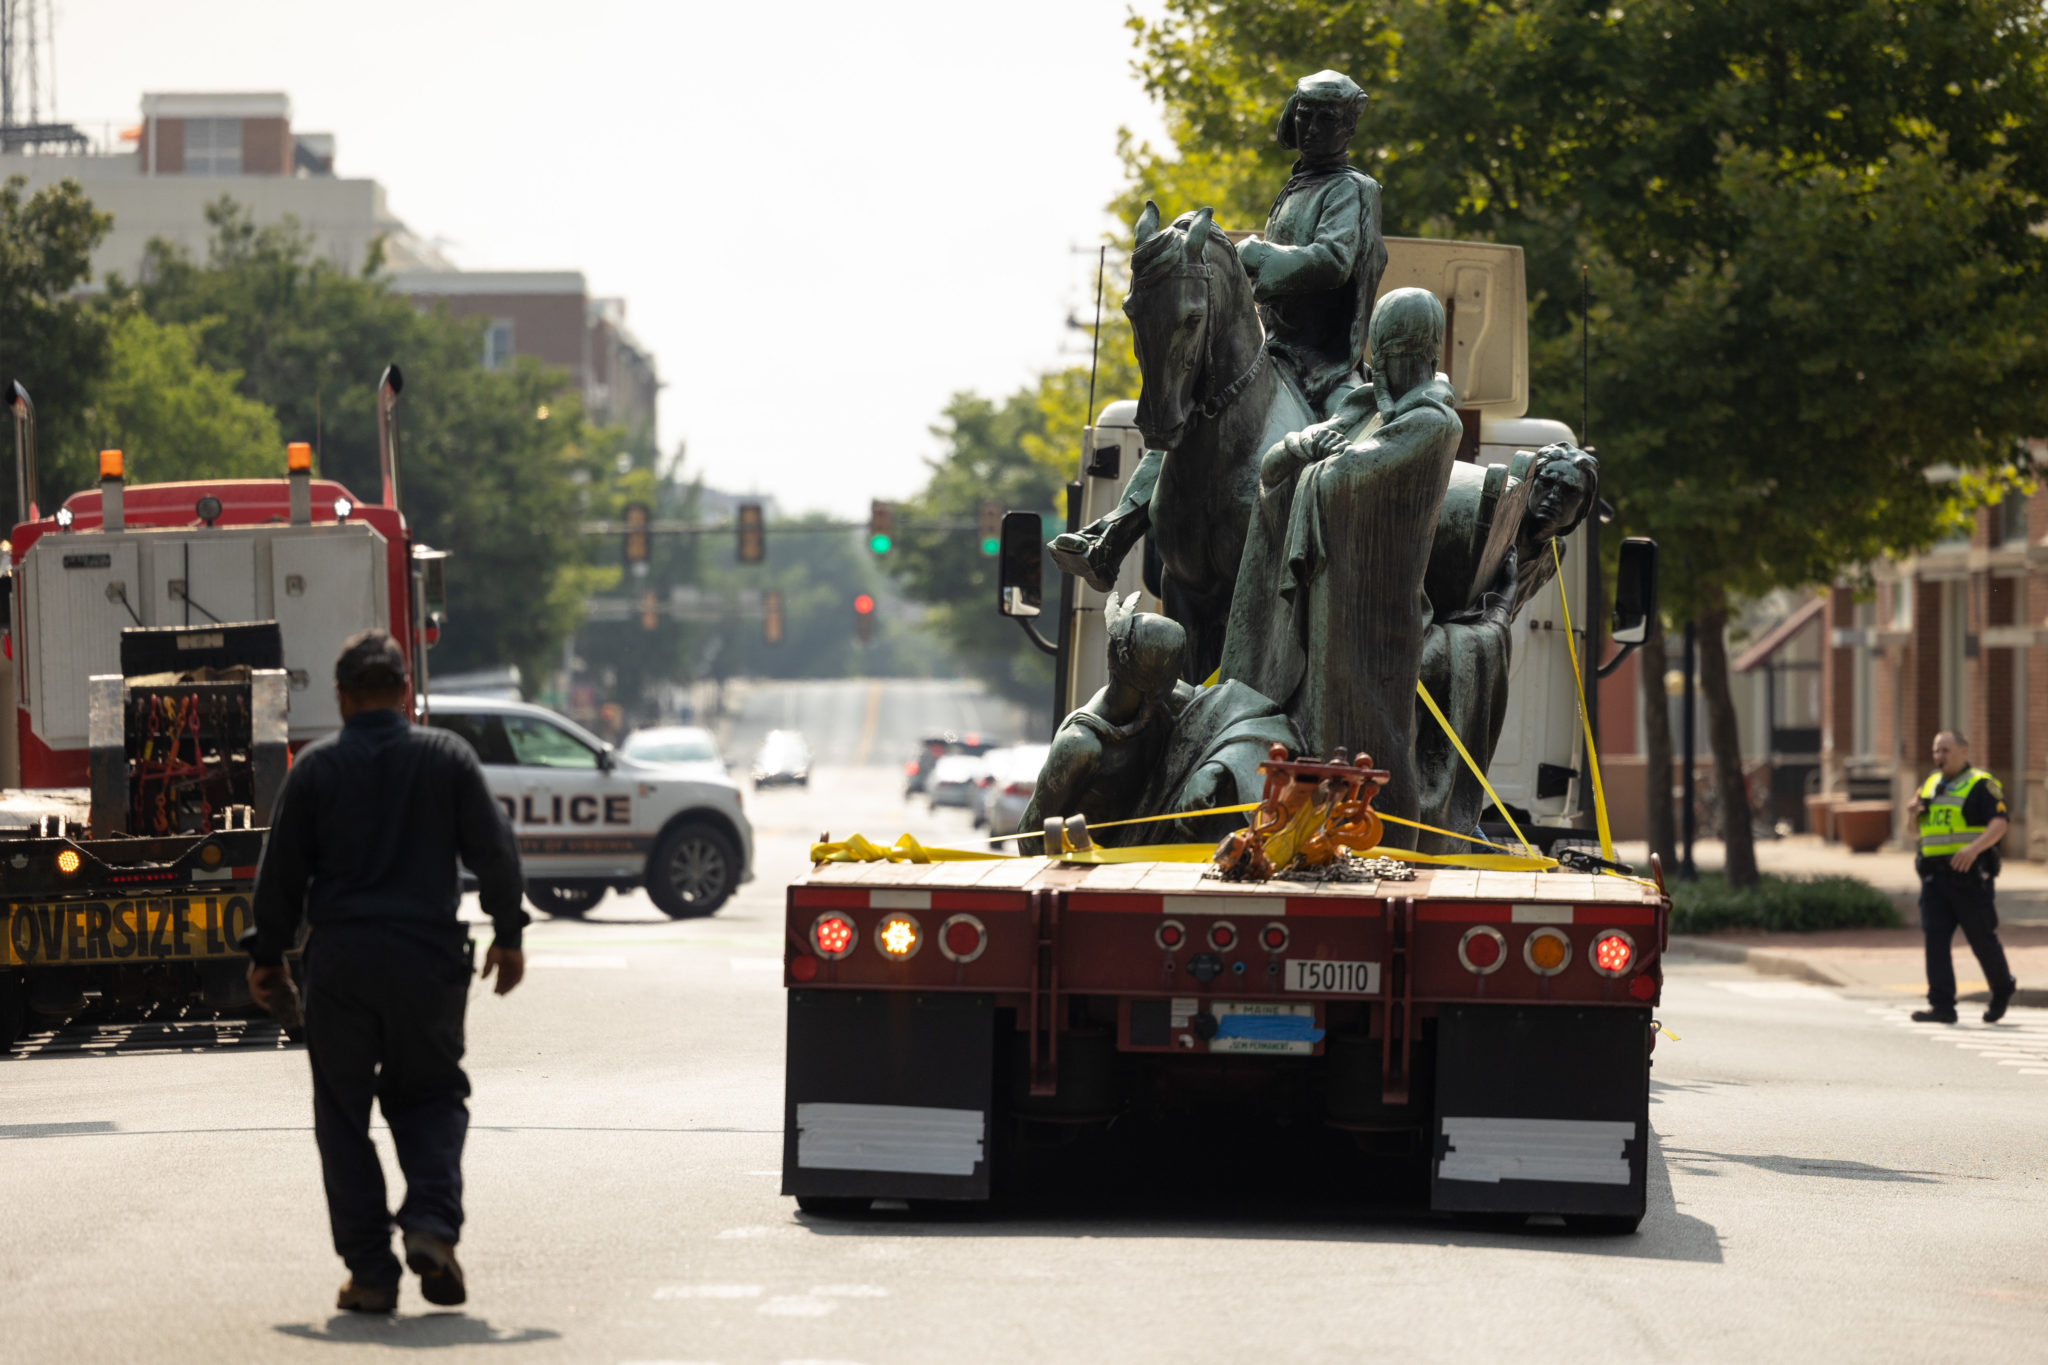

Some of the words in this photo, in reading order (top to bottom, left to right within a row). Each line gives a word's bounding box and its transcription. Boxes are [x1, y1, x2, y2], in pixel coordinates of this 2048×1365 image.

[496, 794, 631, 824] OLICE
[11, 898, 191, 961] OVERSIZE
[205, 896, 251, 953] LO
[1297, 962, 1369, 991] T50110
